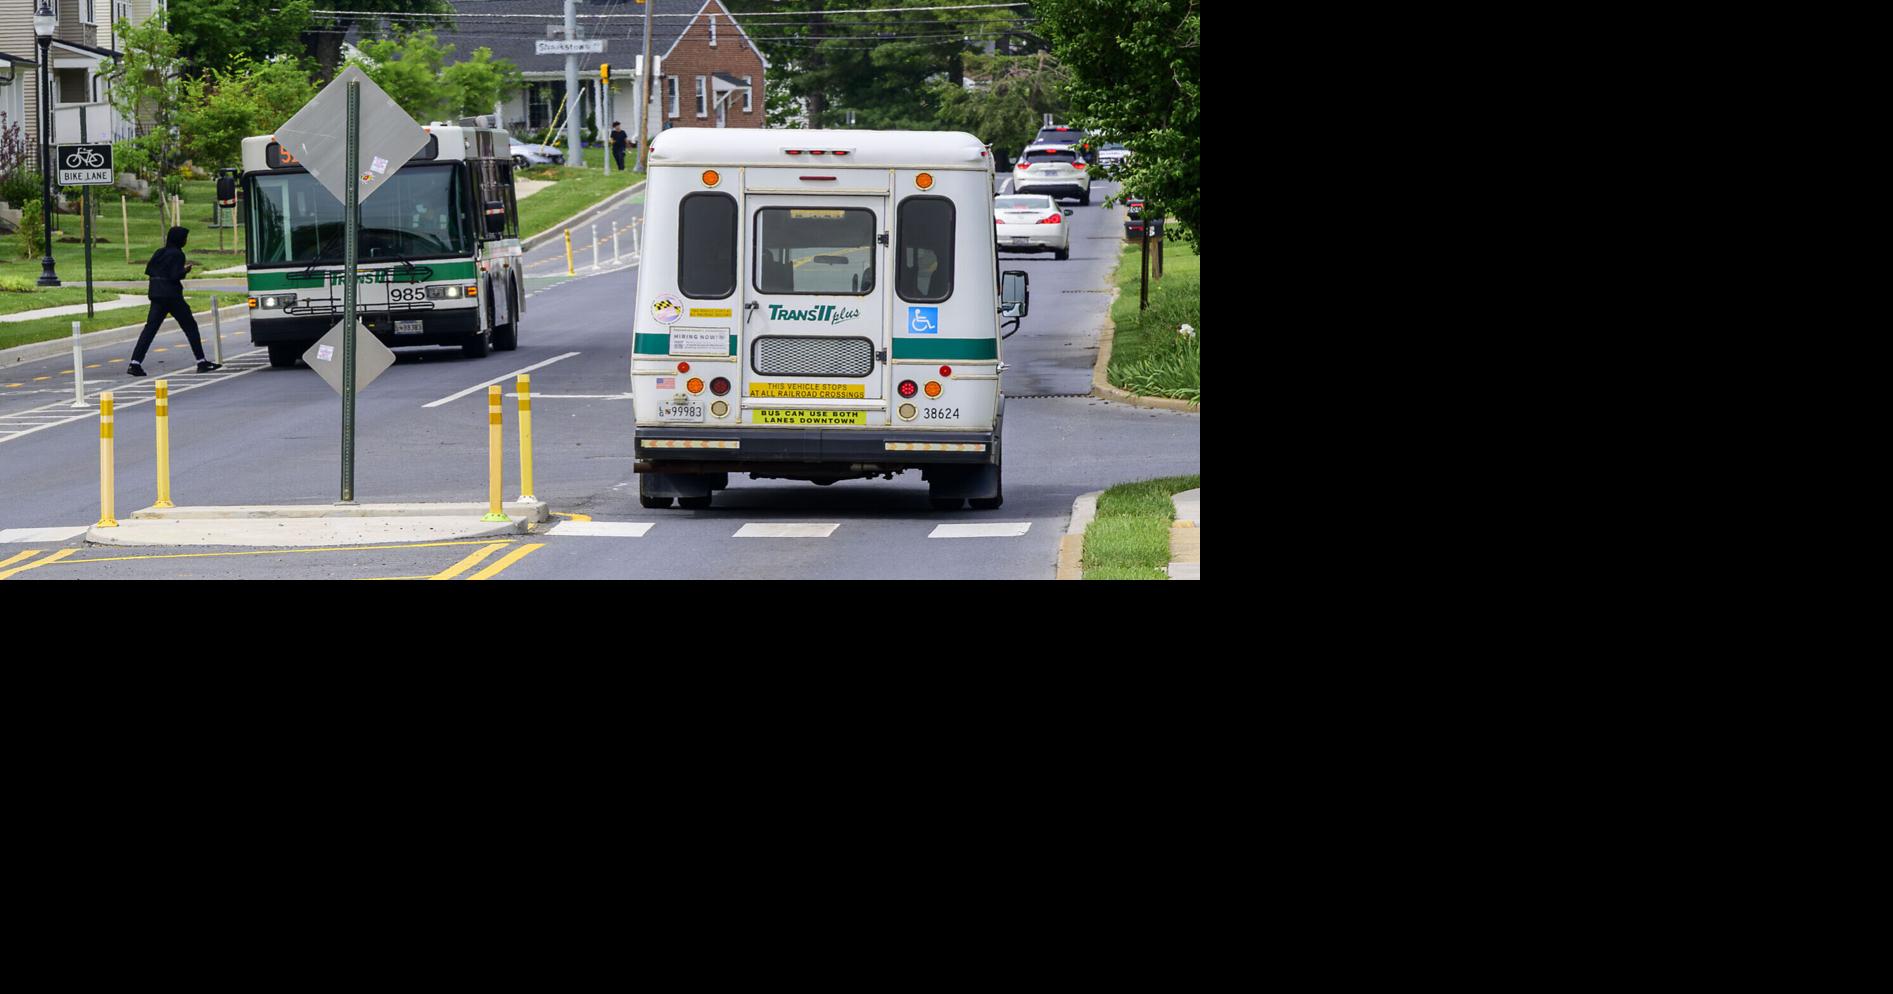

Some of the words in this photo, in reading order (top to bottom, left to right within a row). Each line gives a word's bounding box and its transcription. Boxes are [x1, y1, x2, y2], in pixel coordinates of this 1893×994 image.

[64, 172, 83, 181] BIKE
[86, 171, 107, 180] LANE
[391, 288, 425, 302] 985
[831, 307, 861, 325] plus
[778, 390, 818, 398] RAILROAD
[671, 406, 702, 417] 99983
[923, 407, 959, 419] 38624
